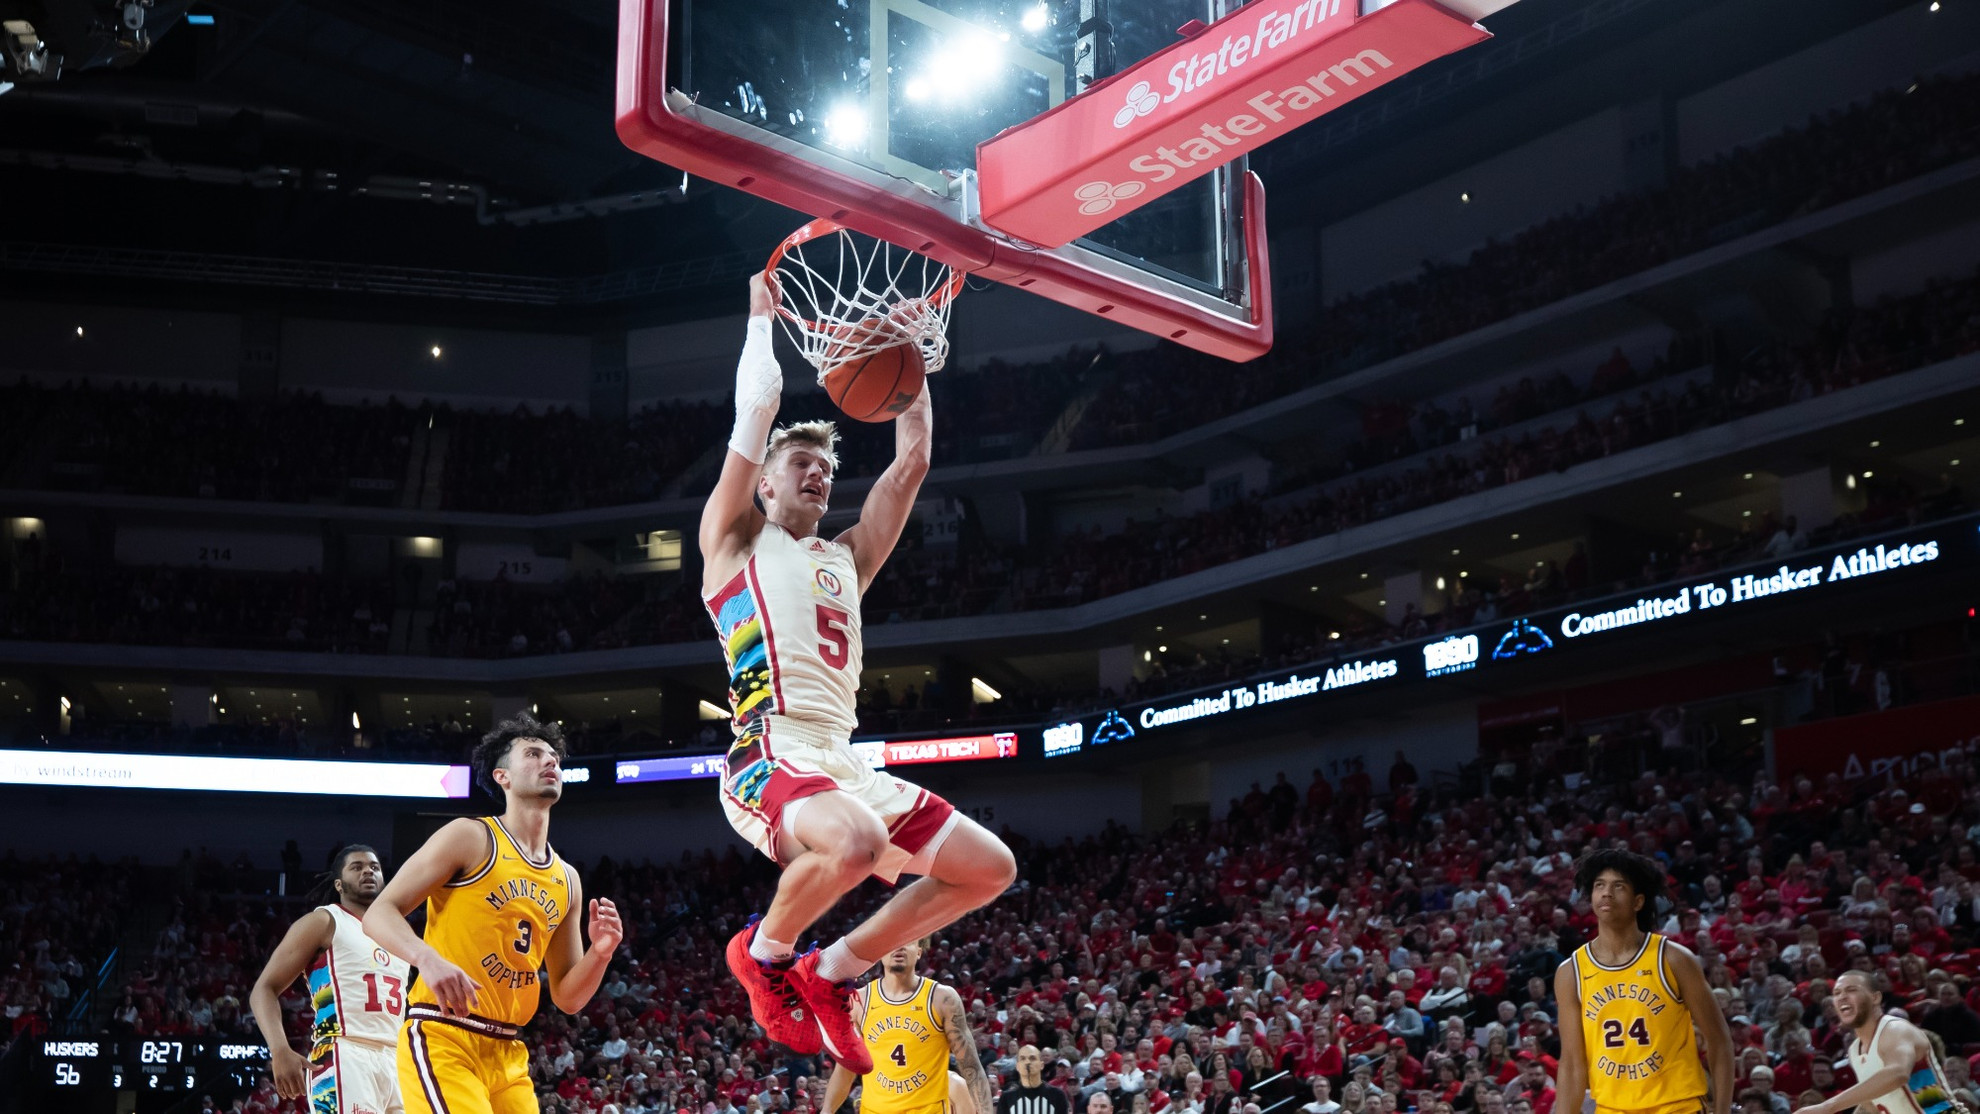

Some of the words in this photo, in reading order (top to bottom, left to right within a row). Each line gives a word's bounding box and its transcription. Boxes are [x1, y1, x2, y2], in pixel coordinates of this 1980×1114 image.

[924, 521, 958, 536] 216
[199, 547, 232, 561] 214
[500, 561, 532, 574] 215
[1561, 587, 1691, 638] Committed
[1693, 582, 1727, 610] To
[1731, 565, 1823, 603] Husker
[1828, 540, 1939, 582] Athletes
[815, 603, 849, 671] 5
[1423, 634, 1479, 671] 1890
[1139, 690, 1231, 729] Committed
[1232, 686, 1256, 710] To
[1257, 674, 1321, 705] Husker
[1322, 659, 1397, 691] Athletes
[889, 744, 939, 761] TEXAS
[939, 741, 980, 757] TECH
[37, 765, 133, 779] windstream
[691, 762, 706, 774] 24
[706, 758, 727, 773] TC
[485, 878, 560, 932] MINNESOTA
[513, 919, 533, 955] 3
[363, 973, 402, 1017] 13
[1585, 983, 1666, 1021] MINNESOTA
[868, 1016, 931, 1043] MINNESOTA
[1603, 1017, 1651, 1049] 24
[44, 1041, 99, 1057] HUSKERS
[141, 1041, 183, 1063] 8:27
[890, 1043, 907, 1067] 4
[55, 1063, 81, 1085] 56
[142, 1065, 167, 1073] PERIOD
[1597, 1050, 1664, 1080] GOPHERS
[113, 1074, 122, 1088] 3
[149, 1074, 158, 1088] 2
[186, 1075, 195, 1089] 3
[876, 1069, 928, 1094] GOPHERS
